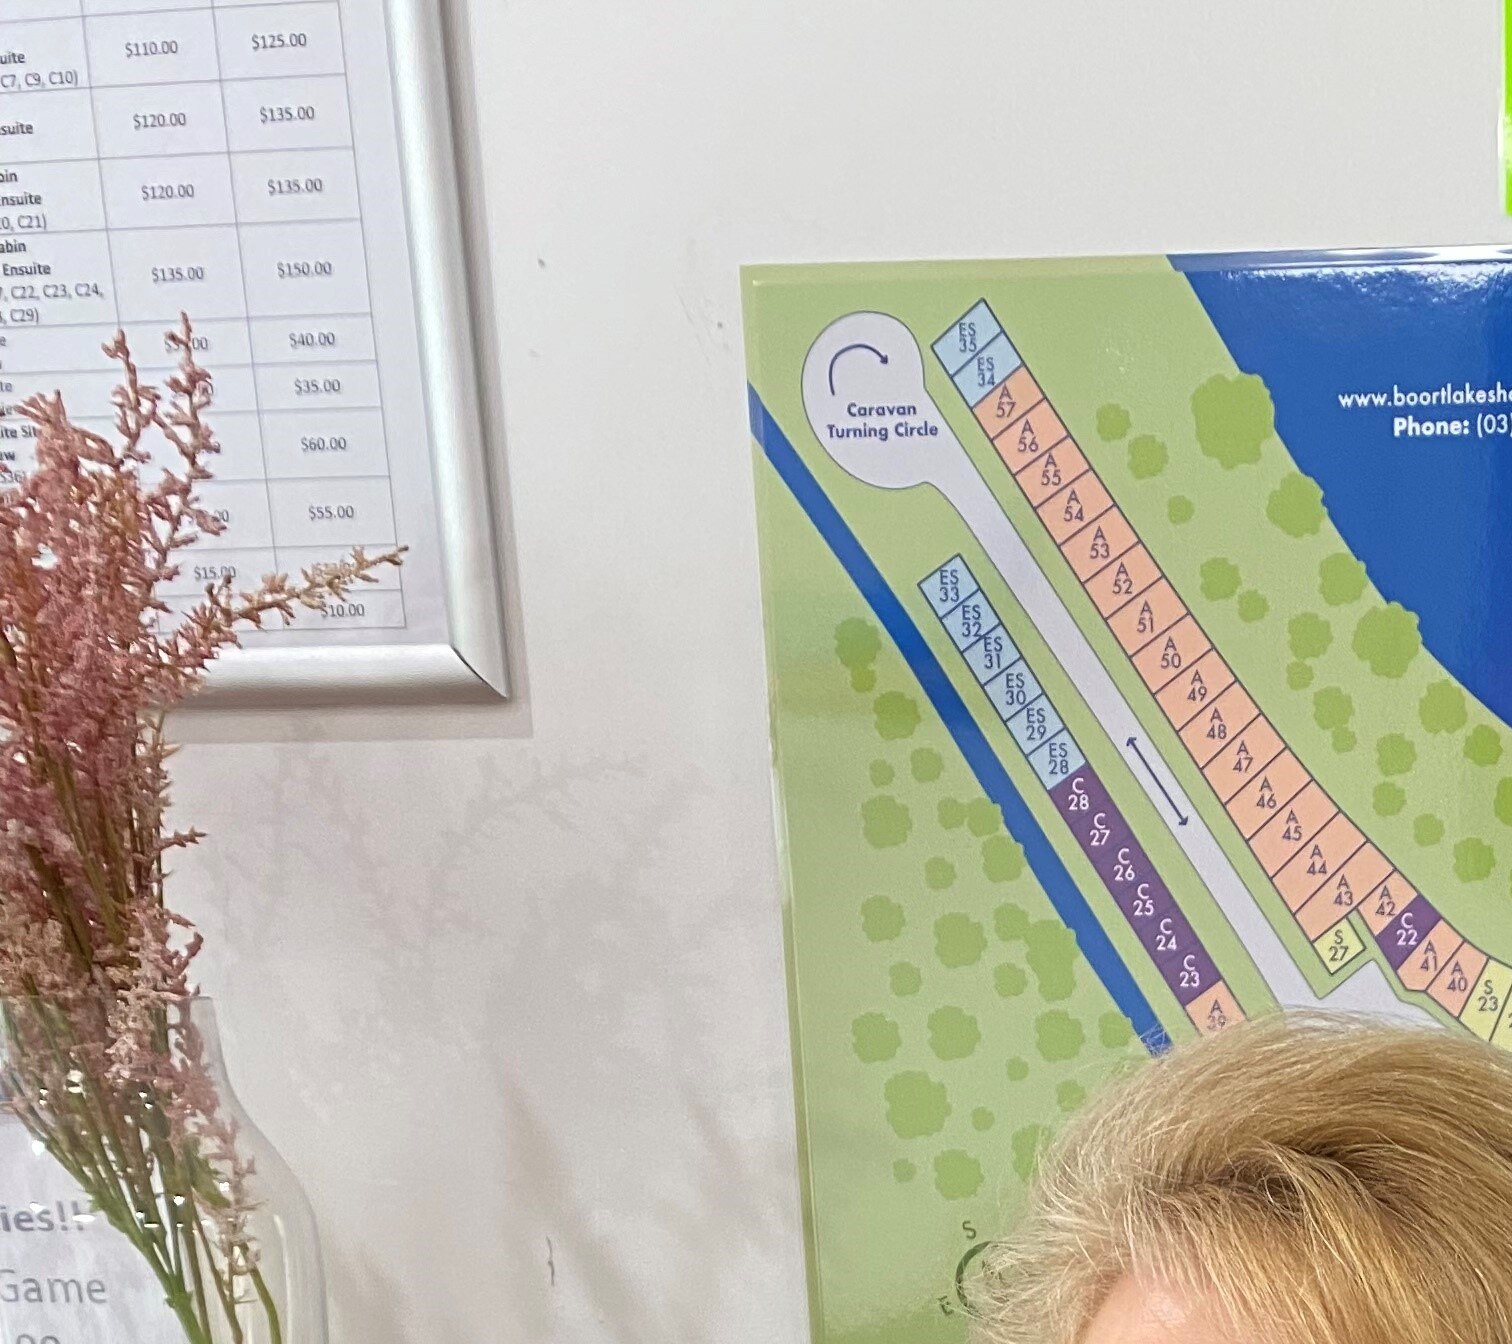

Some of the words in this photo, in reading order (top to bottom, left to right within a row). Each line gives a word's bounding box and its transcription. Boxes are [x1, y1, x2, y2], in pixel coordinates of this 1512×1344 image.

[125, 40, 177, 57] $110.00
[252, 33, 307, 50] $125.00
[133, 112, 186, 130] $120.00
[260, 105, 315, 124] $135.00
[142, 184, 194, 201] $120.00
[268, 178, 323, 195] $135.00
[3, 263, 51, 276] Ensuite
[151, 266, 204, 282] $135.00
[277, 261, 332, 279] $150.00
[289, 331, 335, 349] $40.00
[295, 378, 340, 394] $35.00
[999, 384, 1012, 399] A
[847, 402, 917, 418] Caravan
[996, 401, 1016, 418] 57
[827, 424, 889, 441] Turning
[895, 422, 938, 436] Circle
[1394, 417, 1470, 436] Phone:
[301, 436, 346, 453] $60.00
[309, 506, 354, 520] $55.00
[961, 606, 981, 620] ES
[961, 622, 981, 636] 32
[1094, 813, 1106, 829] C
[1286, 810, 1298, 824] A
[1090, 830, 1110, 845] 27
[1282, 826, 1302, 841] 45
[1401, 913, 1413, 929] C
[1334, 930, 1344, 944] S
[1397, 930, 1418, 945] 22
[1329, 946, 1348, 961] 27
[1484, 980, 1493, 994] S
[1478, 997, 1498, 1012] 23
